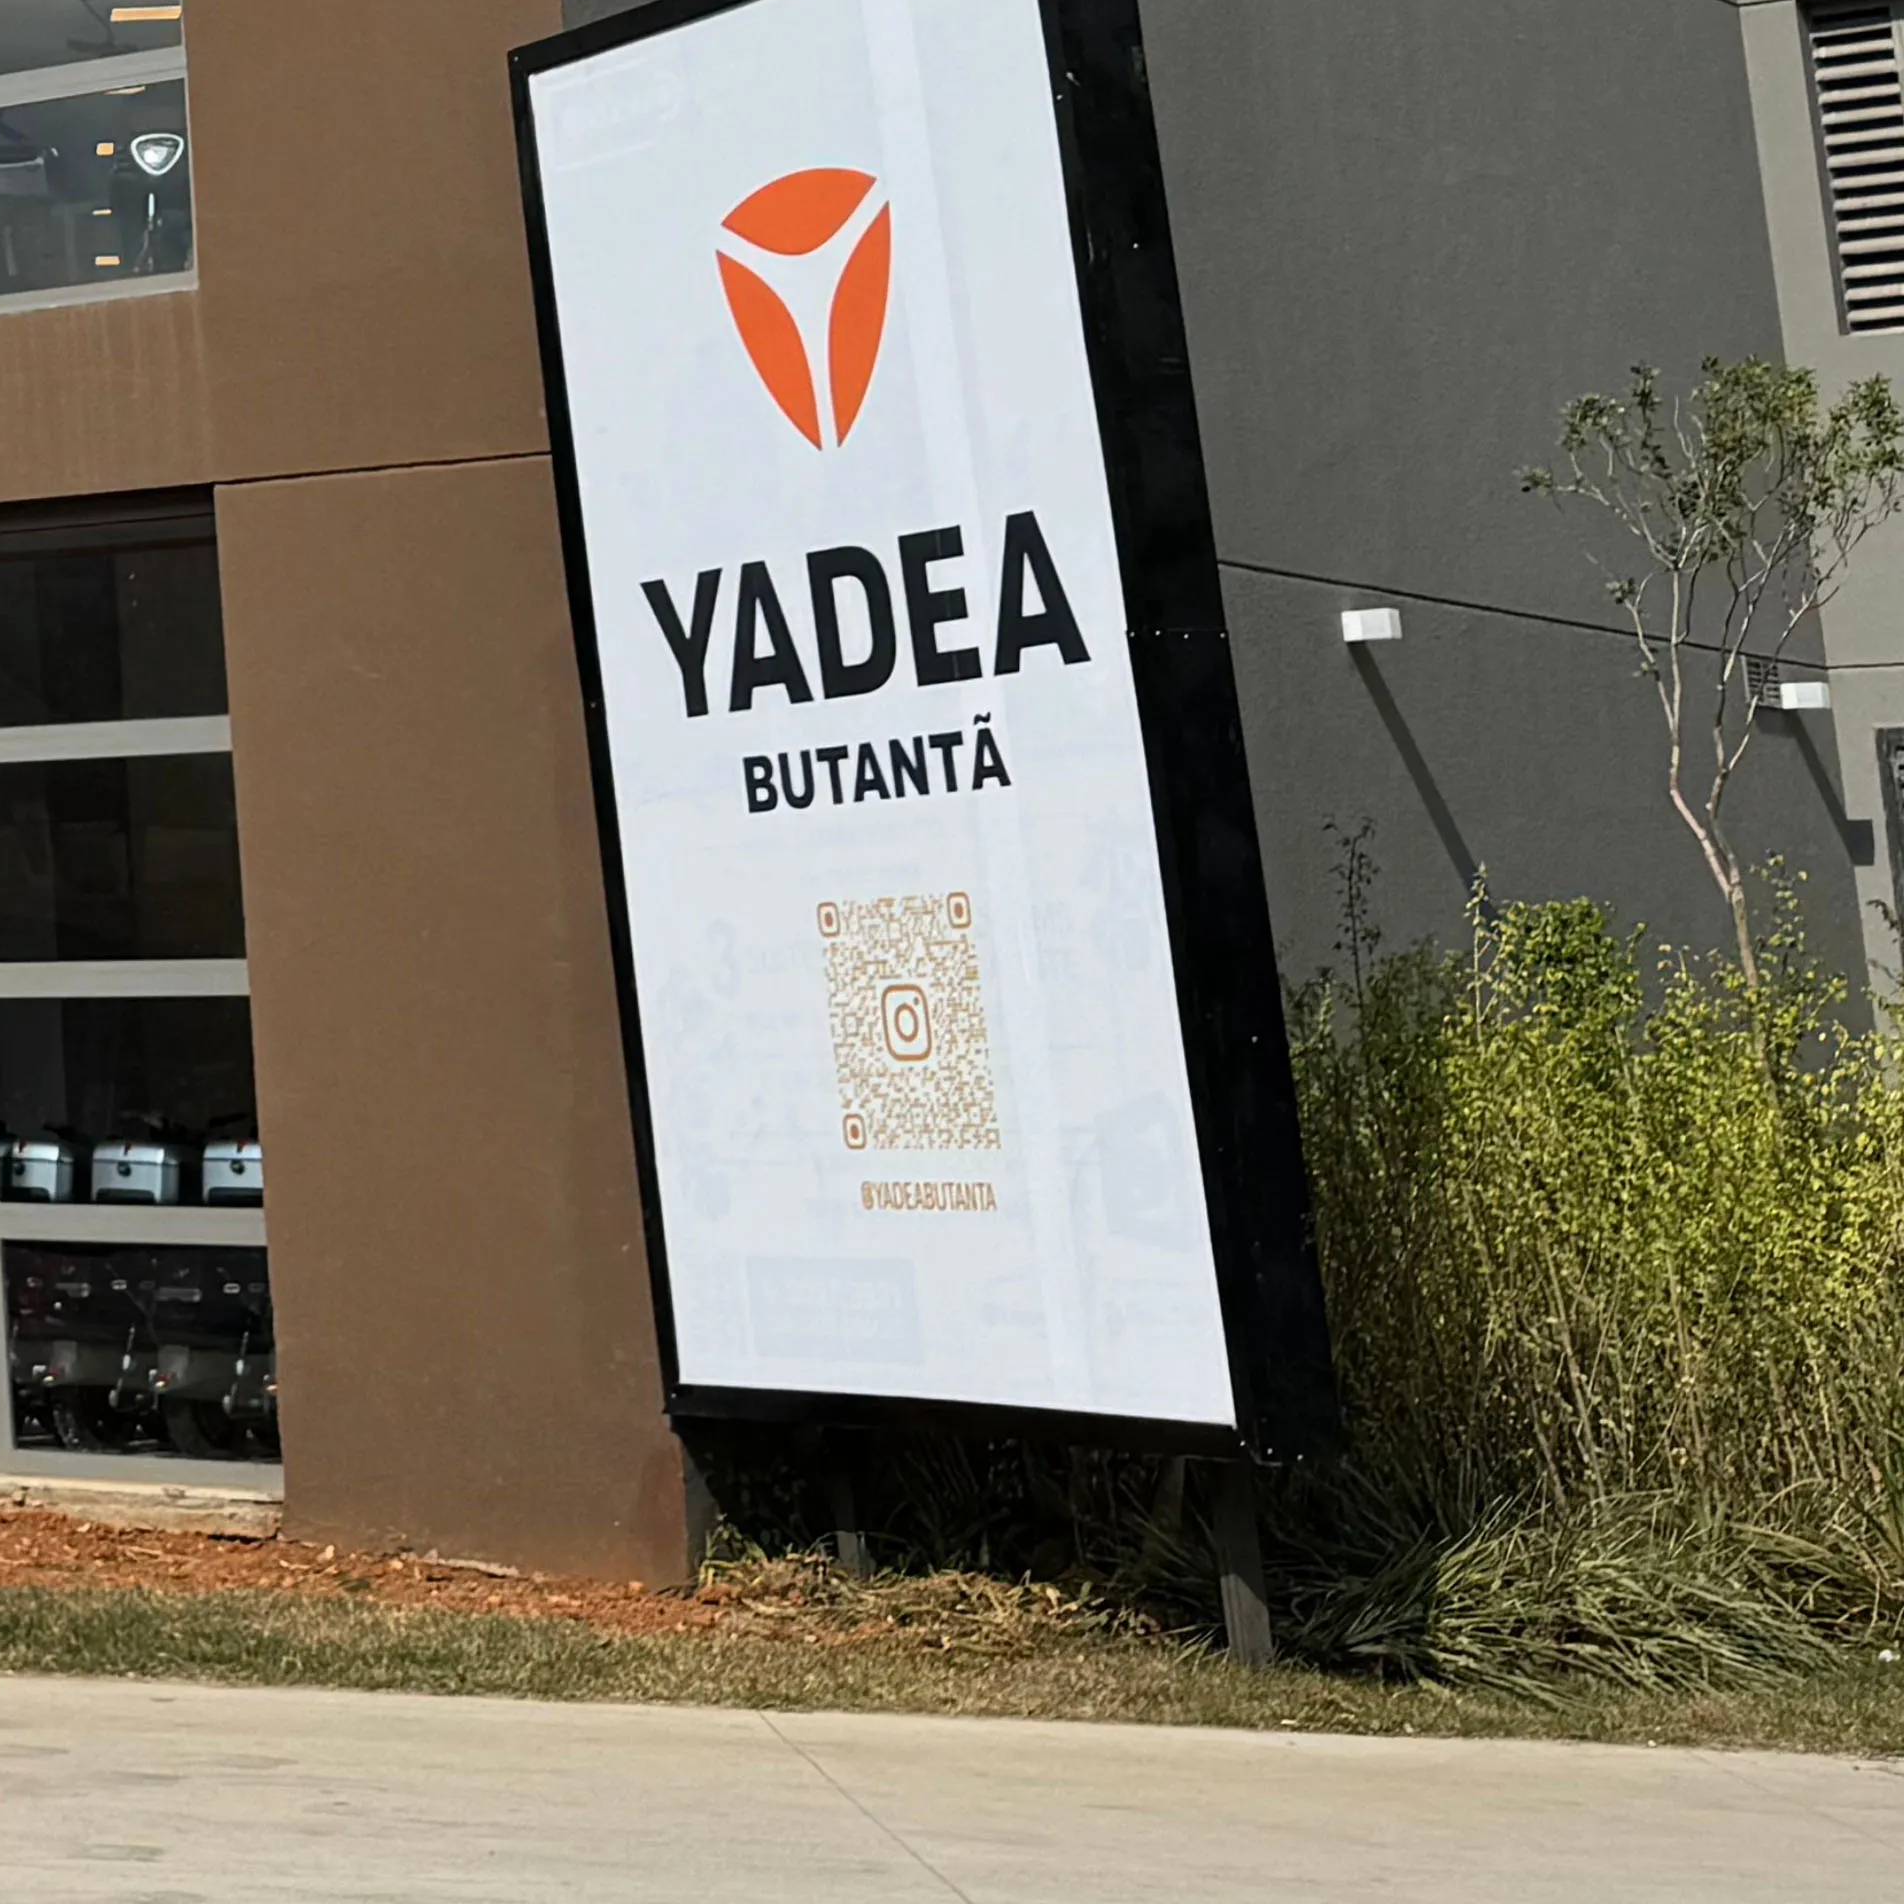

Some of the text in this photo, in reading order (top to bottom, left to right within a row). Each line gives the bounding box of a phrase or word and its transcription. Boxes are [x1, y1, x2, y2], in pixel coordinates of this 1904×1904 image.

[640, 510, 1092, 718] YADEA
[742, 711, 1012, 814] BUTANTÃ
[860, 1180, 998, 1212] @YADEABUTANTA
